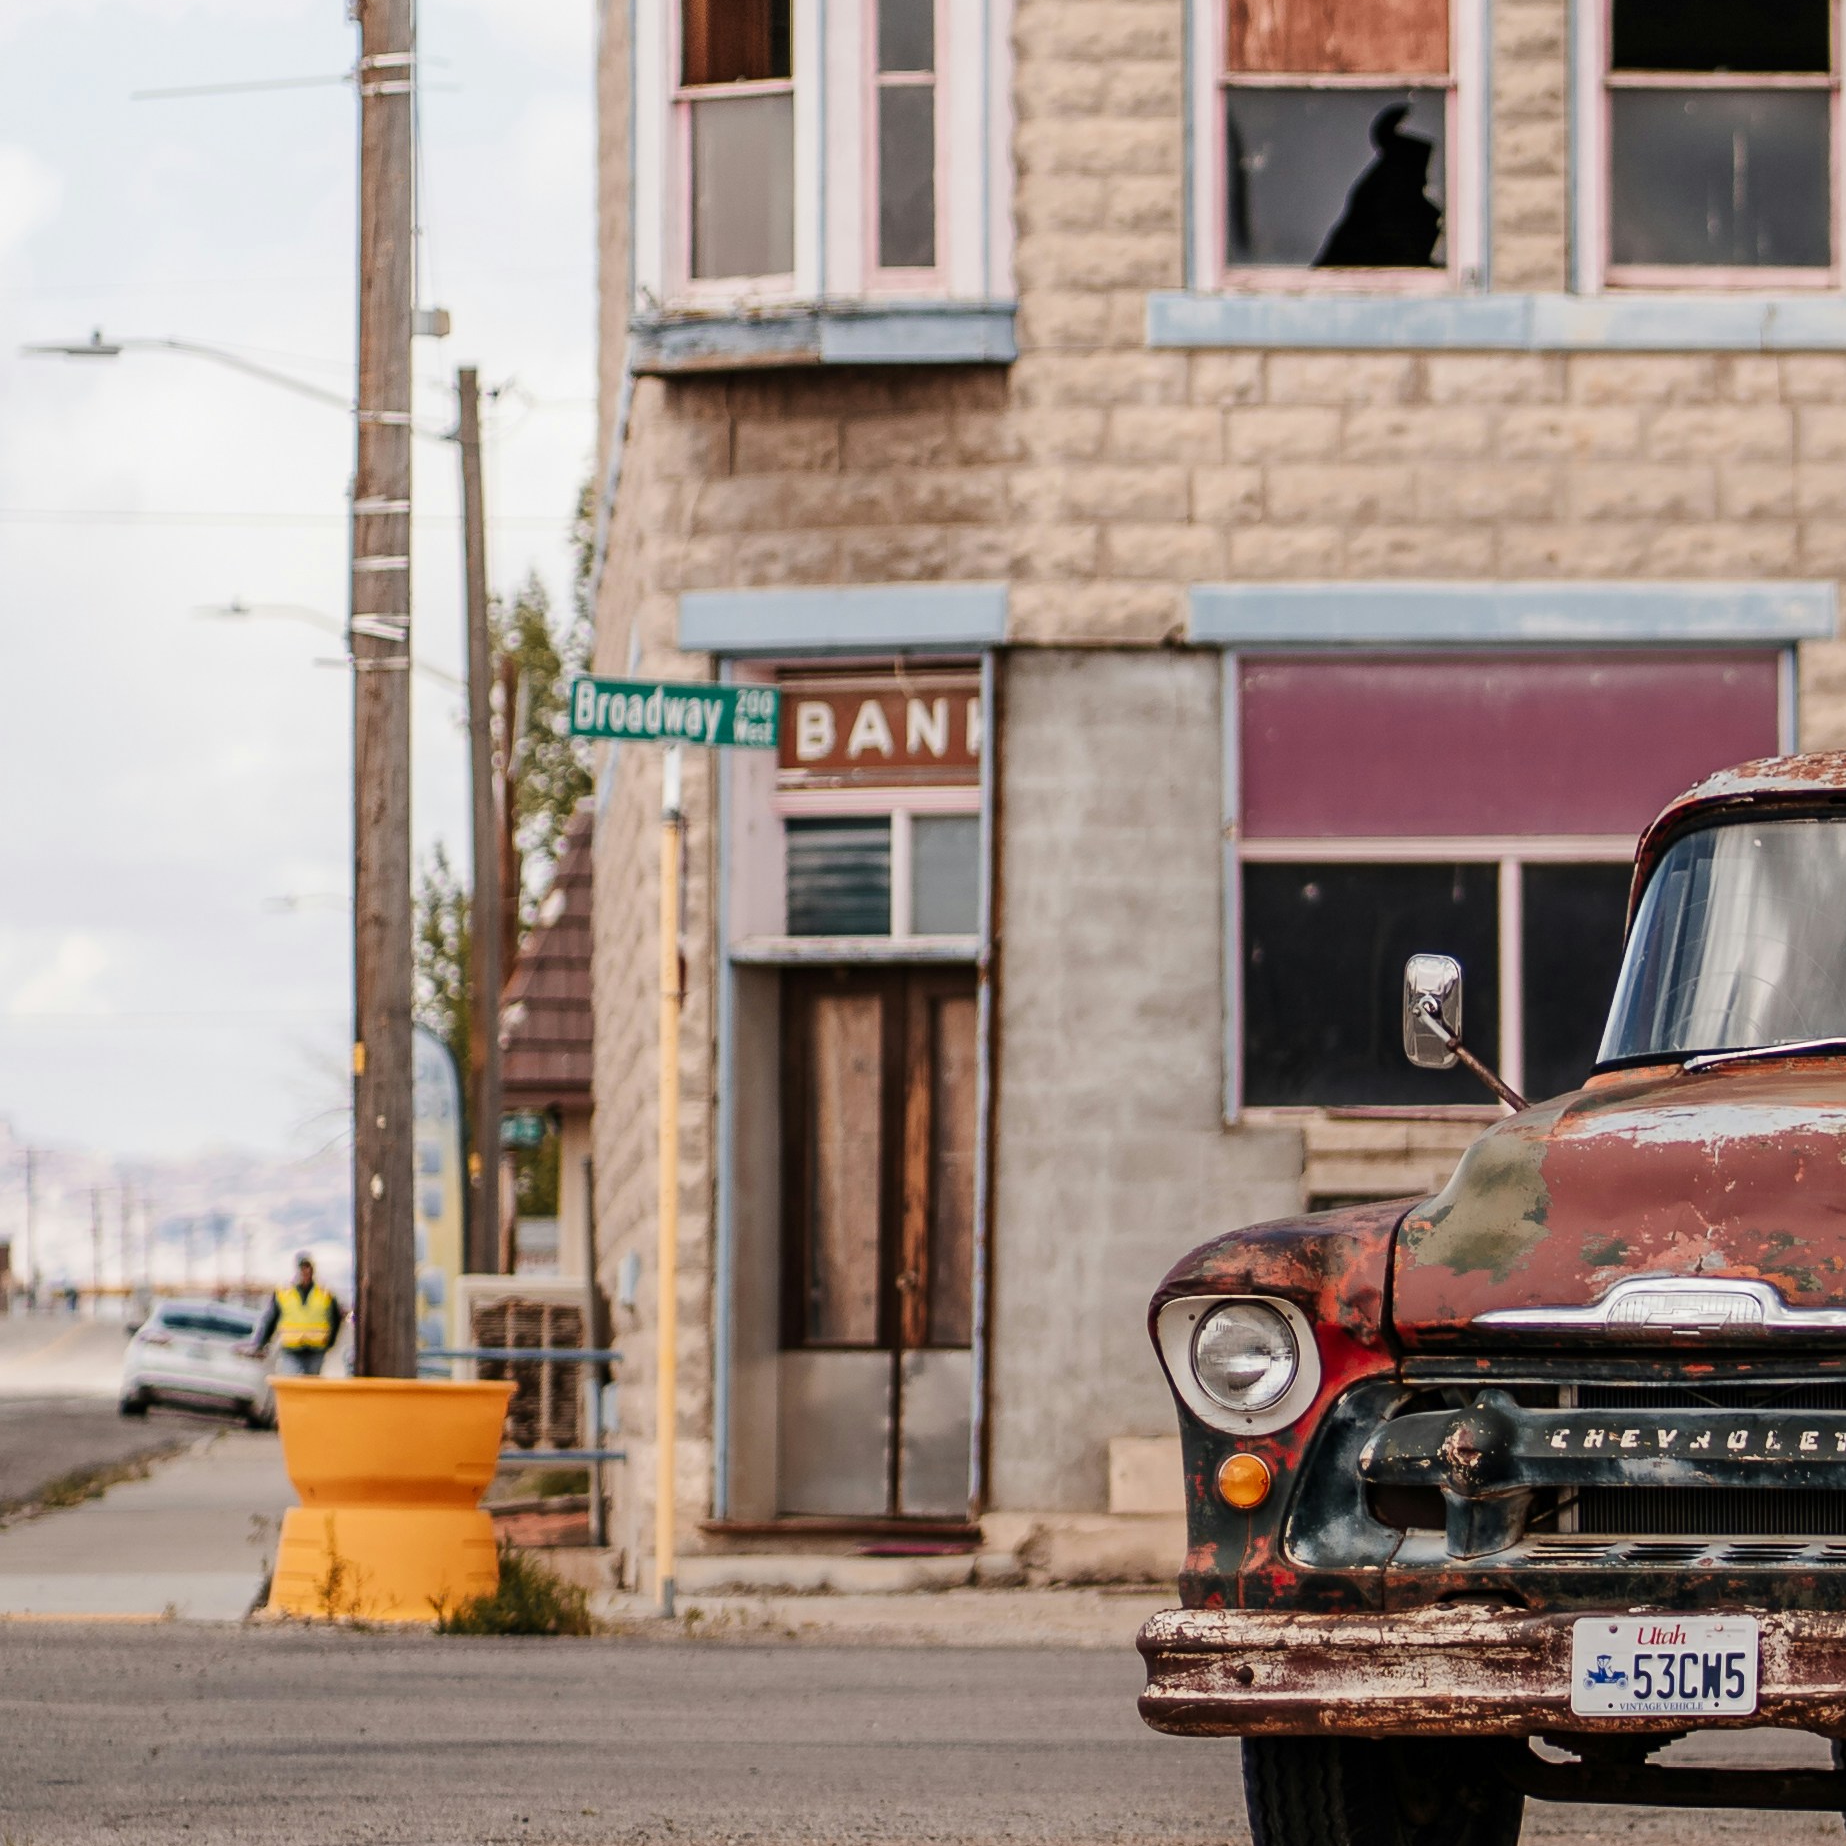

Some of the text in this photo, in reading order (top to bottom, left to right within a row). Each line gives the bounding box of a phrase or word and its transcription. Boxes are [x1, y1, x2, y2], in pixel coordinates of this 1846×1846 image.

[574, 680, 724, 745] Broadway
[735, 688, 777, 719] 200
[732, 716, 776, 745] West
[1637, 1624, 1687, 1645] Utah
[1633, 1653, 1746, 1700] 53CW5
[1619, 1702, 1704, 1712] VINTAGE VEHICLE
